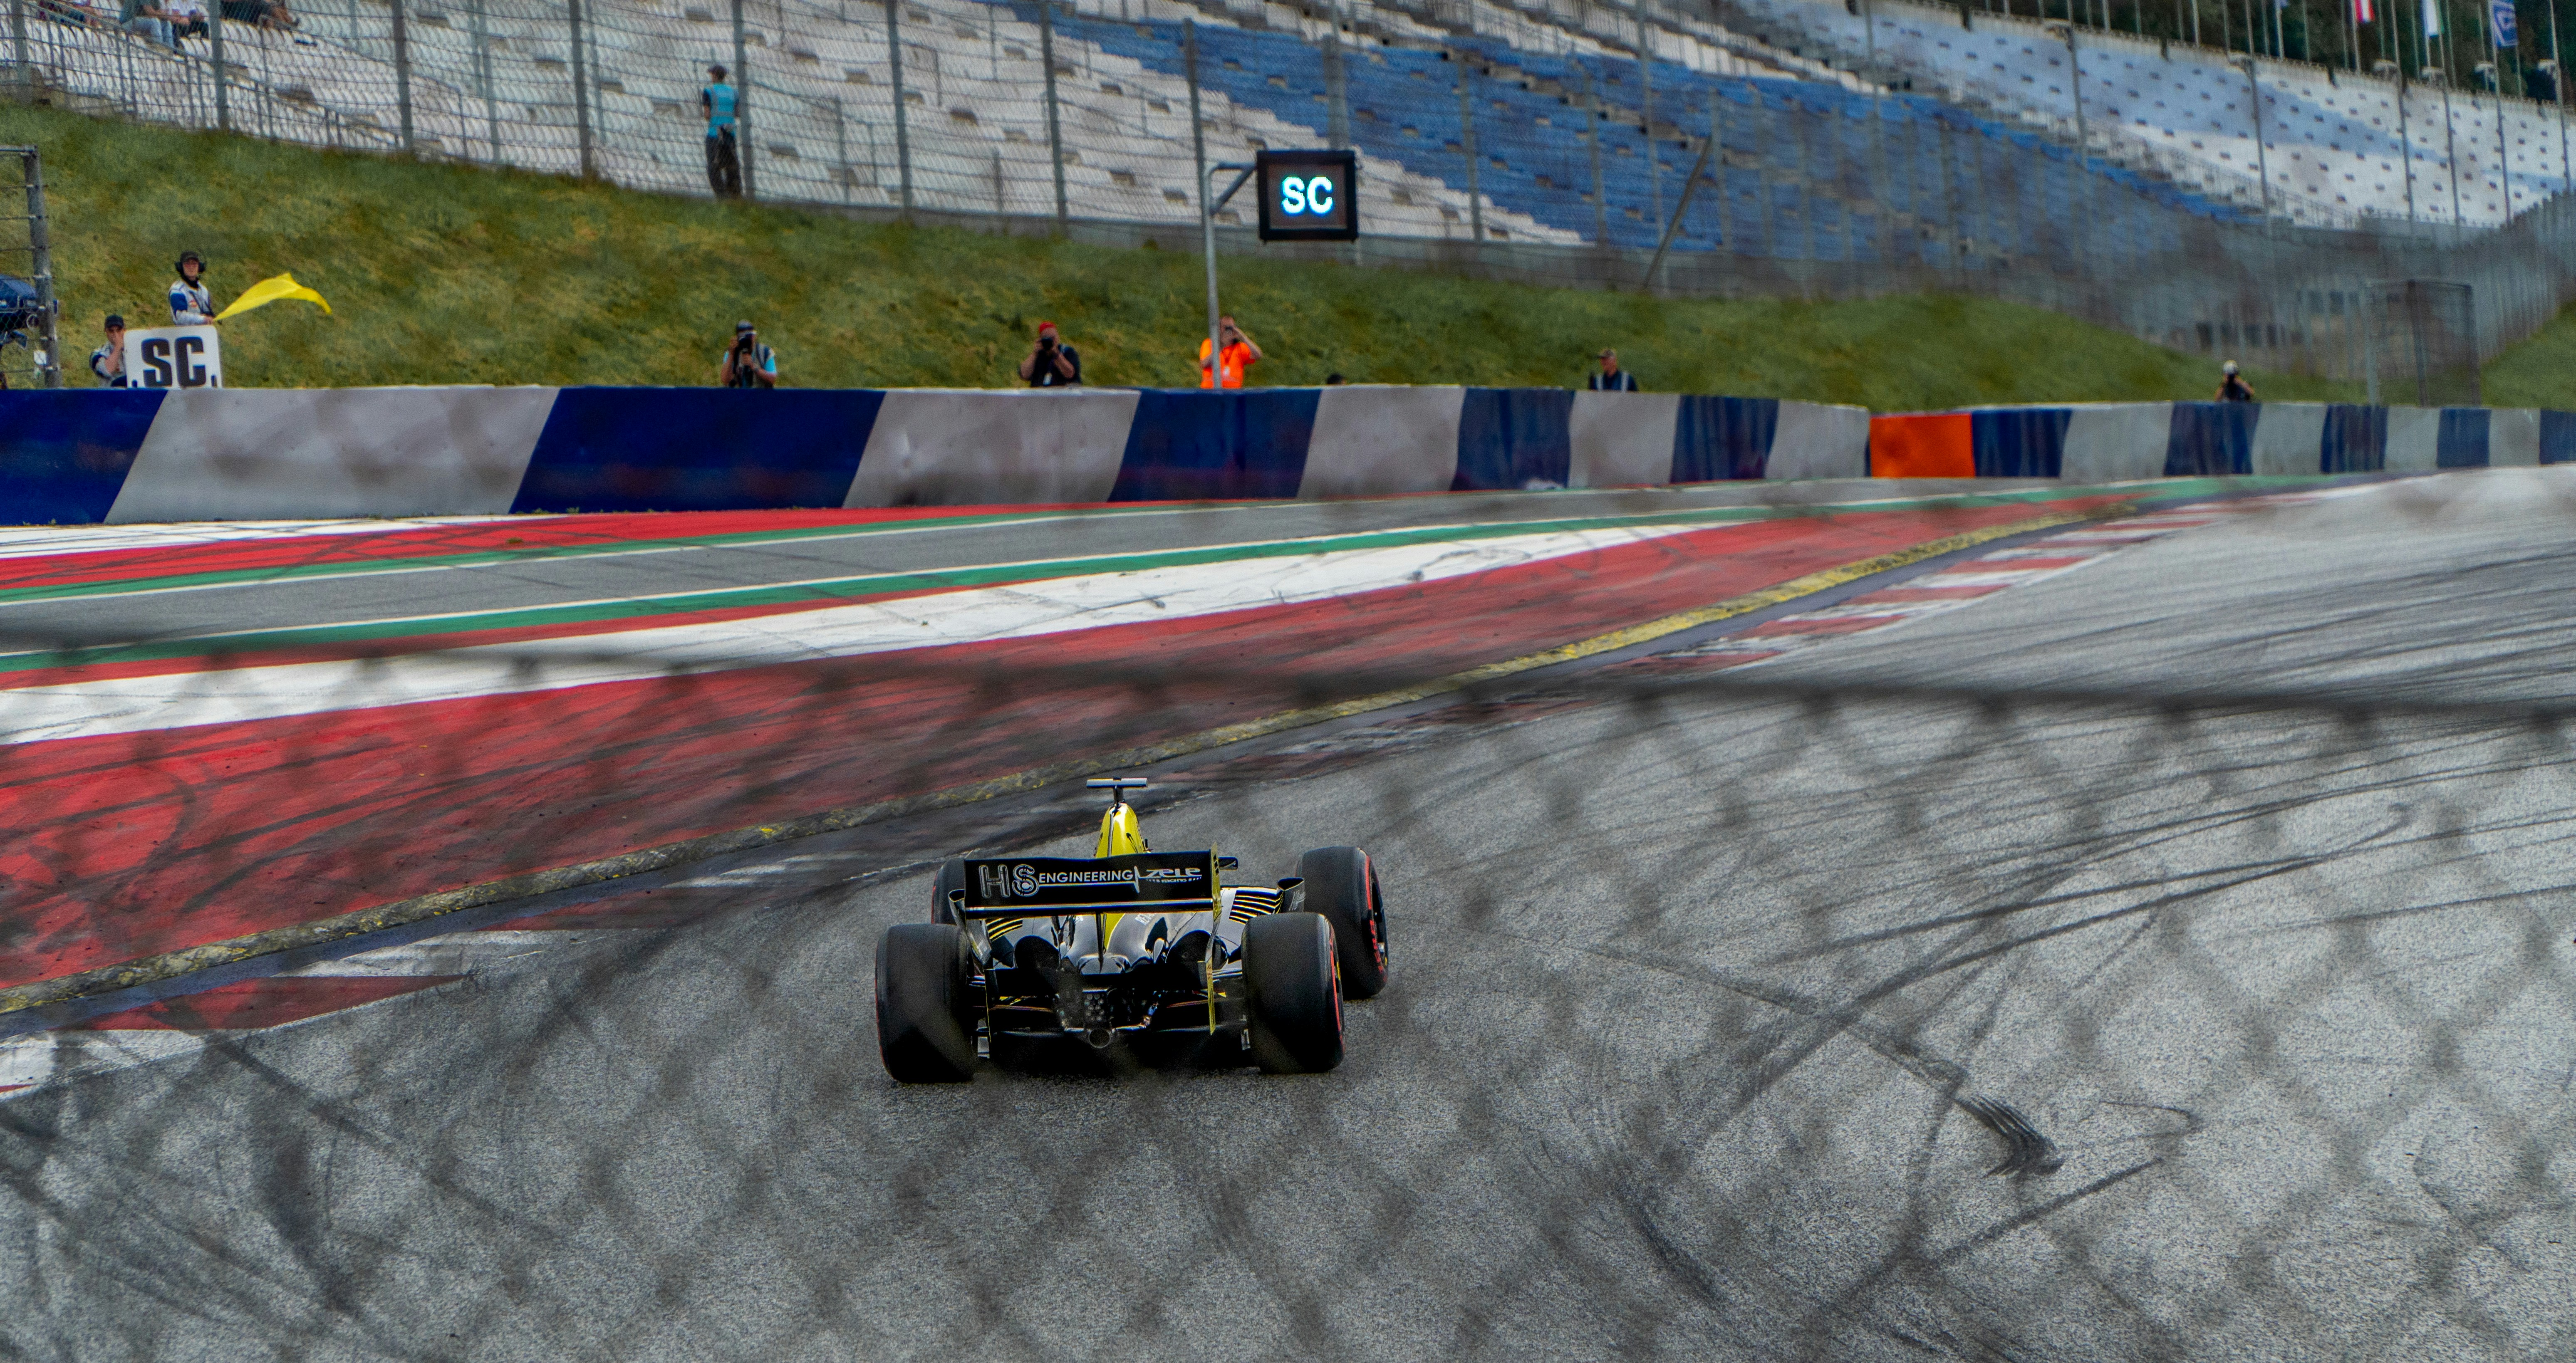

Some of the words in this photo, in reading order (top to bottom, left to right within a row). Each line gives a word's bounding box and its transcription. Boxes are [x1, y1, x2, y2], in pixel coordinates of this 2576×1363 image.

[1281, 175, 1334, 215] SC
[141, 335, 206, 388] SC
[978, 864, 1039, 898] HS
[1039, 869, 1133, 883] ENGINEERING
